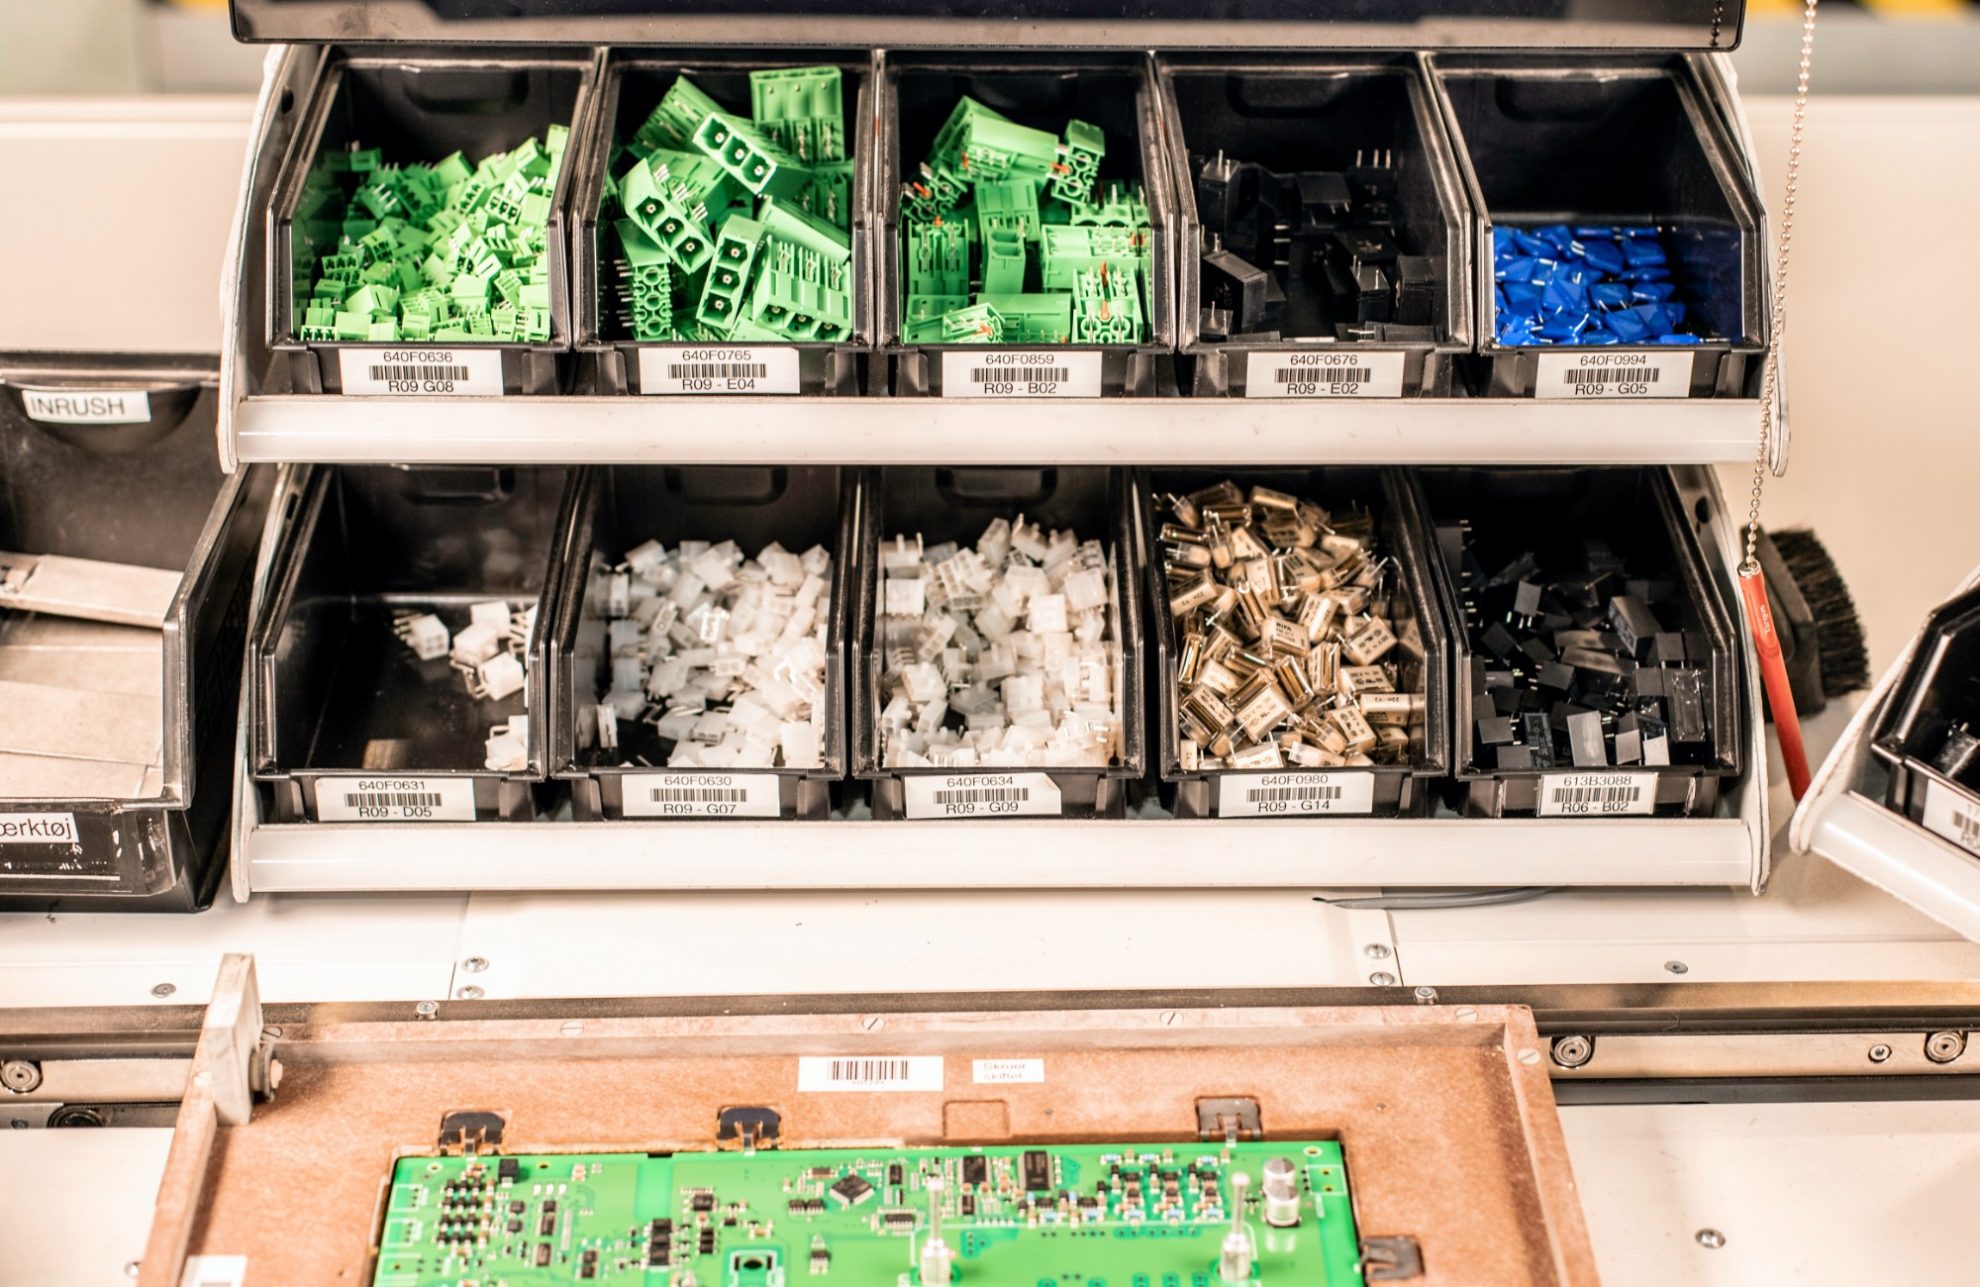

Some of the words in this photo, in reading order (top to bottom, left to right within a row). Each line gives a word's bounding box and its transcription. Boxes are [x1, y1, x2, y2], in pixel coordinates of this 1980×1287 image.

[383, 351, 453, 364] 640F0636
[682, 350, 752, 361] 640F0765
[986, 354, 1055, 366] 640F0859
[1290, 355, 1358, 366] 640F0676
[1581, 355, 1646, 366] 640F0994
[389, 380, 418, 392] R09
[423, 380, 454, 392] G08
[683, 378, 712, 390] R09
[728, 378, 756, 390] E04
[985, 383, 1013, 394] R09
[1028, 382, 1057, 394] B02
[1288, 383, 1316, 395] R09
[1331, 383, 1358, 395] E02
[1576, 383, 1604, 395] R09
[1618, 383, 1647, 395] G05
[30, 397, 125, 417] INRUSH
[359, 780, 425, 791] 640F0631
[665, 776, 732, 786] 640F0630
[948, 776, 1013, 787] 640F0634
[1262, 775, 1329, 786] 640F0980
[1564, 776, 1632, 786] 613B3088
[360, 806, 388, 818] R09
[403, 806, 432, 818] D05
[664, 803, 693, 814] R09
[707, 802, 737, 814] G07
[946, 802, 974, 814] R09
[989, 800, 1018, 813] G09
[1258, 800, 1287, 813] R09
[1301, 799, 1331, 811] G14
[1562, 802, 1589, 814] R06
[1602, 800, 1629, 813] B02
